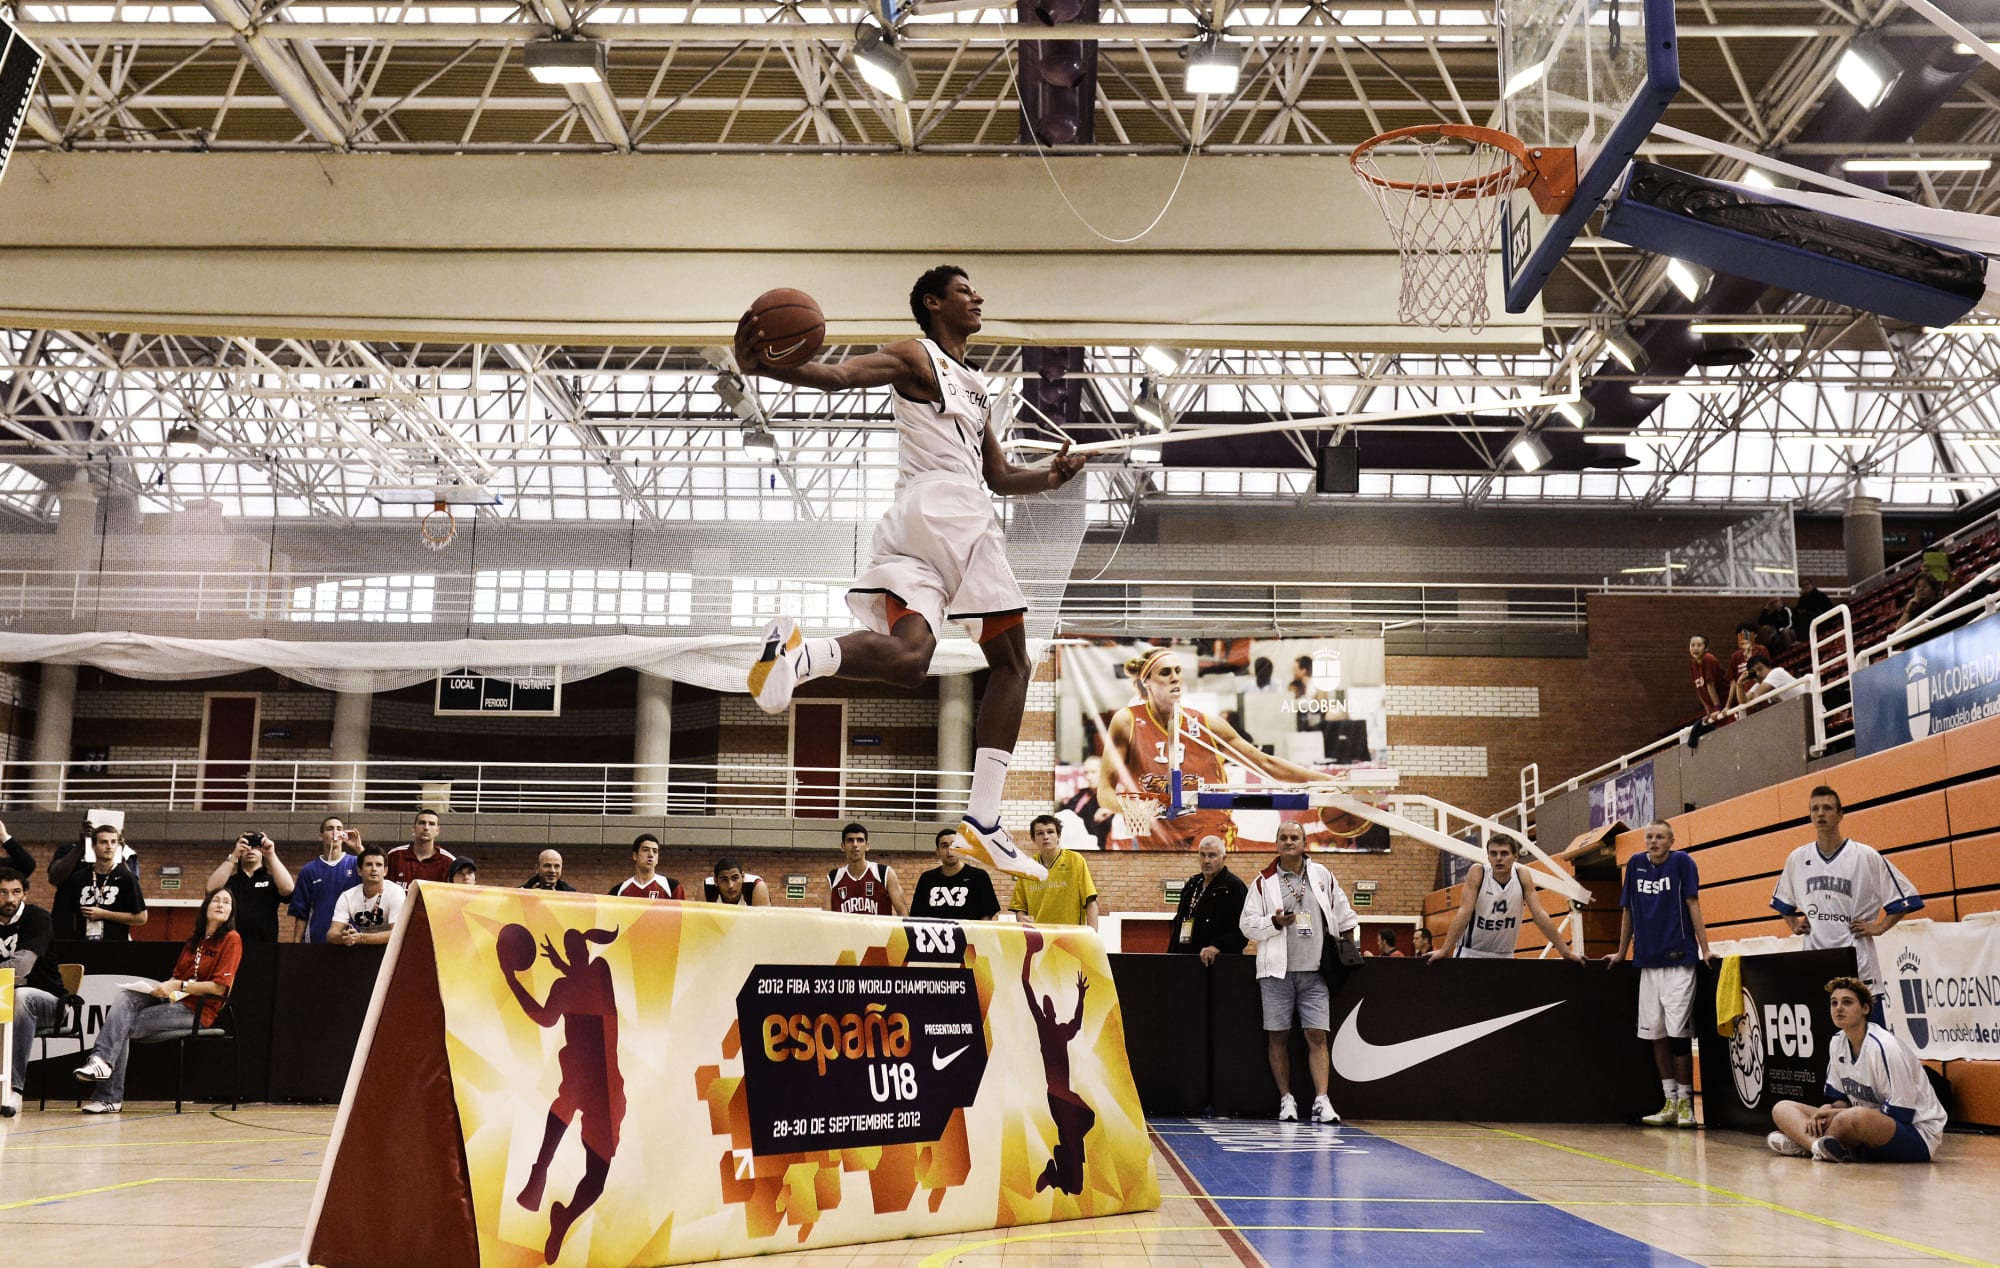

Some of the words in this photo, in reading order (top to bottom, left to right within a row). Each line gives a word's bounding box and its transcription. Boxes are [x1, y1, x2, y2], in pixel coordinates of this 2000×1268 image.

[450, 679, 475, 689] LOCAL
[518, 679, 551, 690] VISITANTE
[485, 698, 508, 707] PERIODO
[1943, 706, 1970, 730] modelo
[1971, 702, 1983, 720] de
[1637, 877, 1670, 894] EESTI
[1491, 899, 1508, 914] 14
[1477, 916, 1516, 930] EESTI
[1818, 913, 1852, 923] EDISON
[758, 978, 783, 994] 2012
[786, 978, 810, 994] FIBA
[814, 979, 835, 994] 3X3
[838, 979, 855, 994] U18
[858, 980, 892, 994] WORLD
[894, 980, 966, 995] CHAMPIONSHIPS
[924, 1024, 961, 1035] PRESENTADO
[961, 1024, 973, 1034] POR
[1975, 1022, 1990, 1043] de
[763, 1003, 912, 1076] españa
[868, 1063, 918, 1102] U18
[773, 1119, 807, 1137] 28-30
[810, 1117, 826, 1134] DE
[829, 1113, 894, 1132] SEPTIEMBRE
[898, 1111, 921, 1127] 2012
